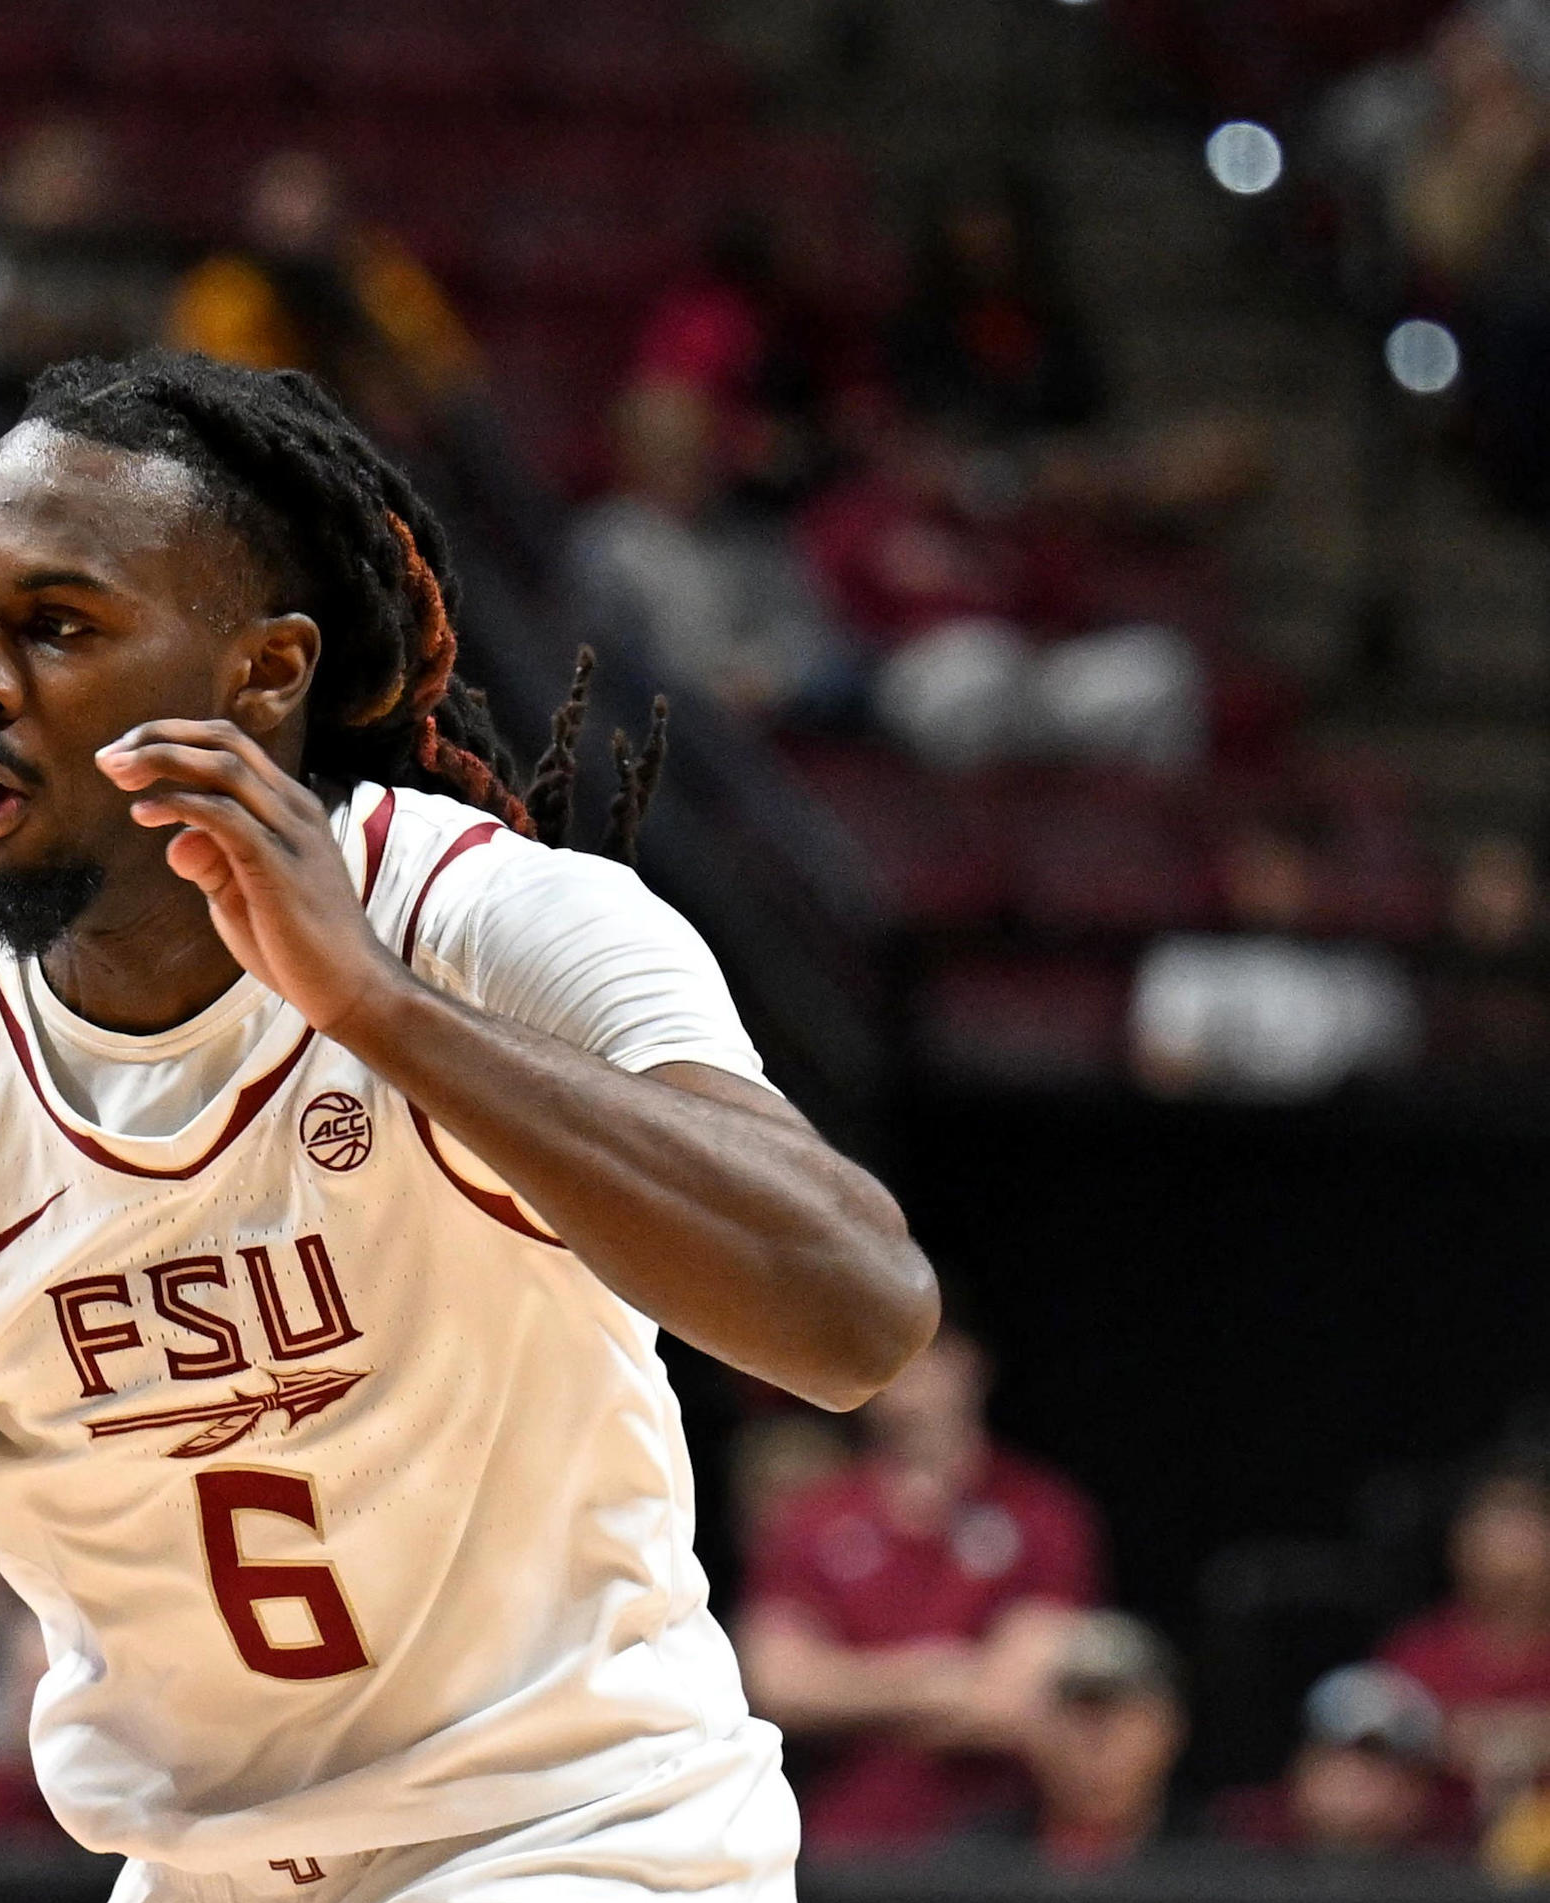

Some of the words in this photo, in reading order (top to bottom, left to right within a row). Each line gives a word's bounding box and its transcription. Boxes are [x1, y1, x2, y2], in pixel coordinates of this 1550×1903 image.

[310, 1112, 366, 1142] ACC
[44, 1233, 364, 1399] FSU
[190, 1462, 380, 1684] 6
